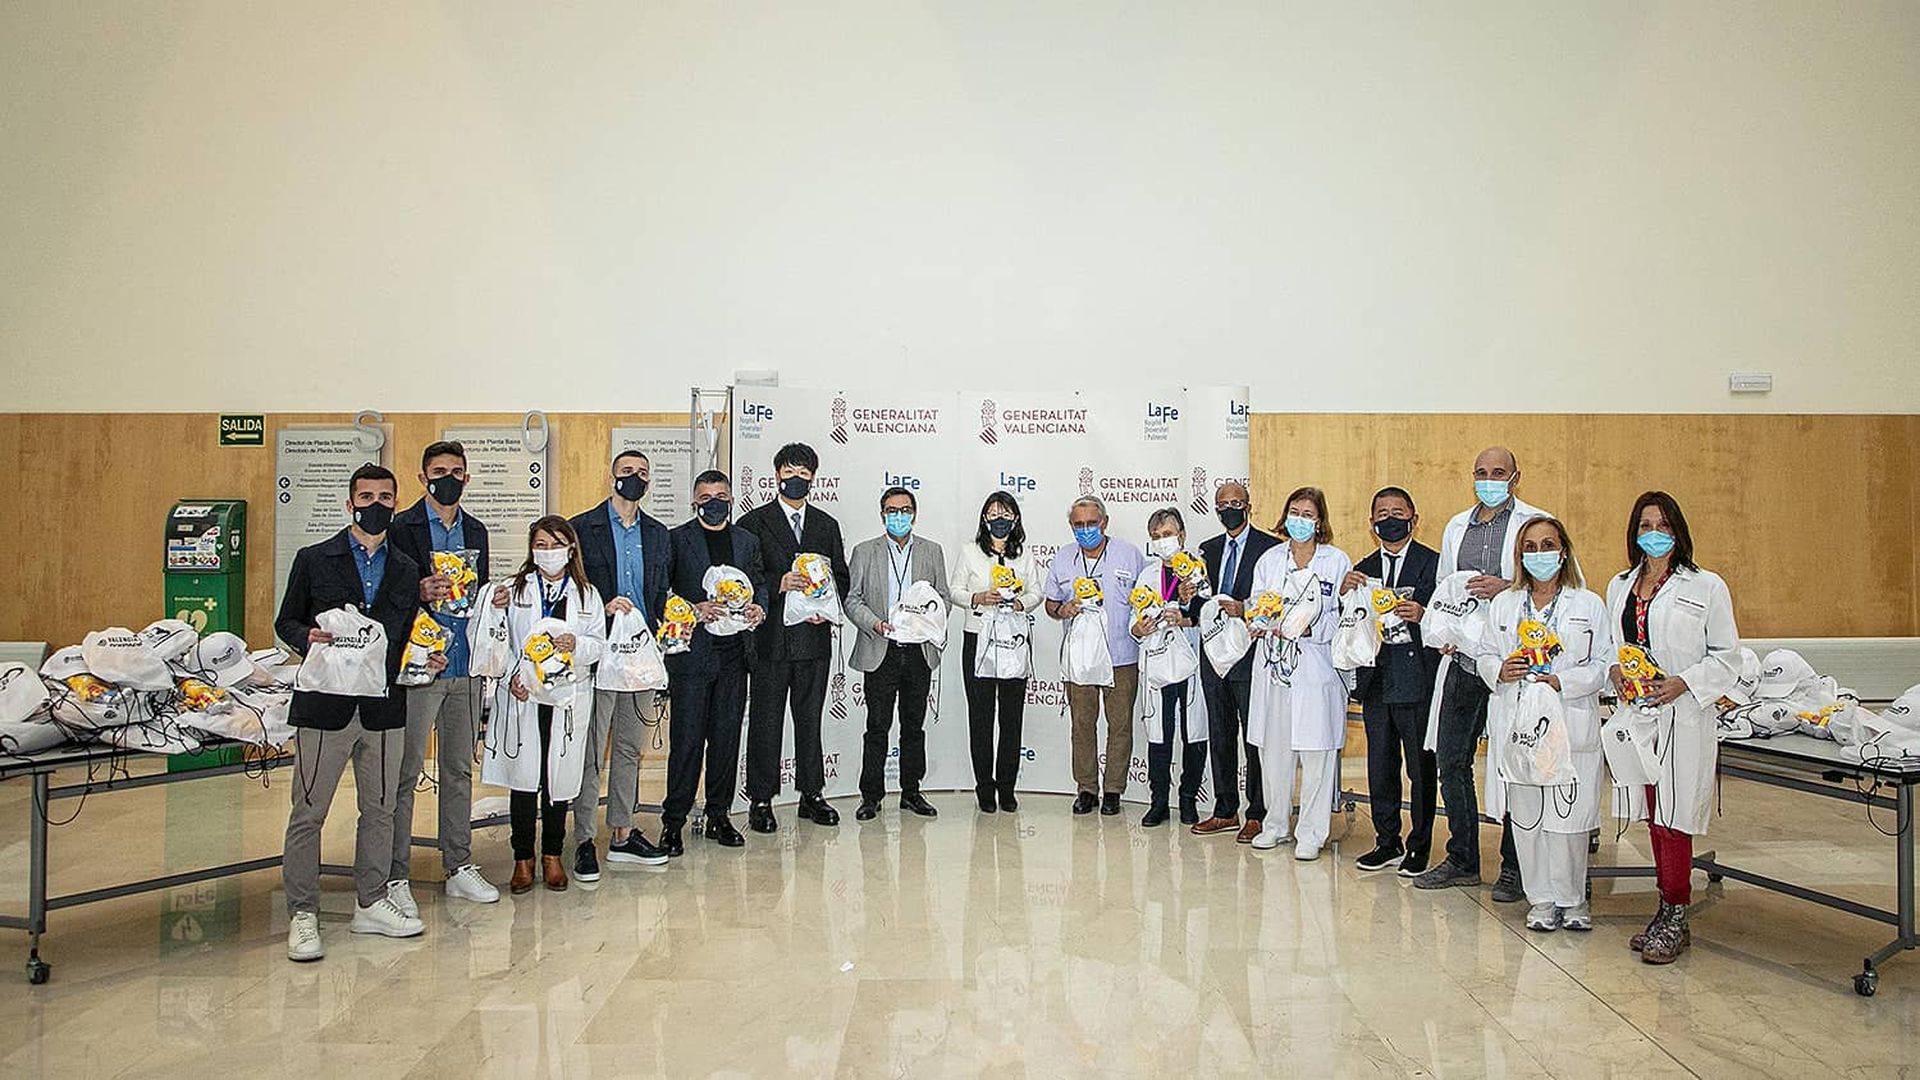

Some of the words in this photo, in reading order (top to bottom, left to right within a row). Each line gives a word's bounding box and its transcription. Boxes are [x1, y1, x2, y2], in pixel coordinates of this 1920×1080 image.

[853, 409, 939, 421] GENERALITAT
[1002, 409, 1088, 421] GENERALITAT
[1148, 402, 1179, 423] LaFe
[221, 419, 263, 431] SALIDA
[854, 422, 938, 434] VALENCIANA
[1003, 423, 1087, 434] VALENCIANA
[1000, 472, 1037, 492] LaFe
[1100, 477, 1179, 489] GENERALITAT
[1100, 491, 1179, 503] VALENCIANA
